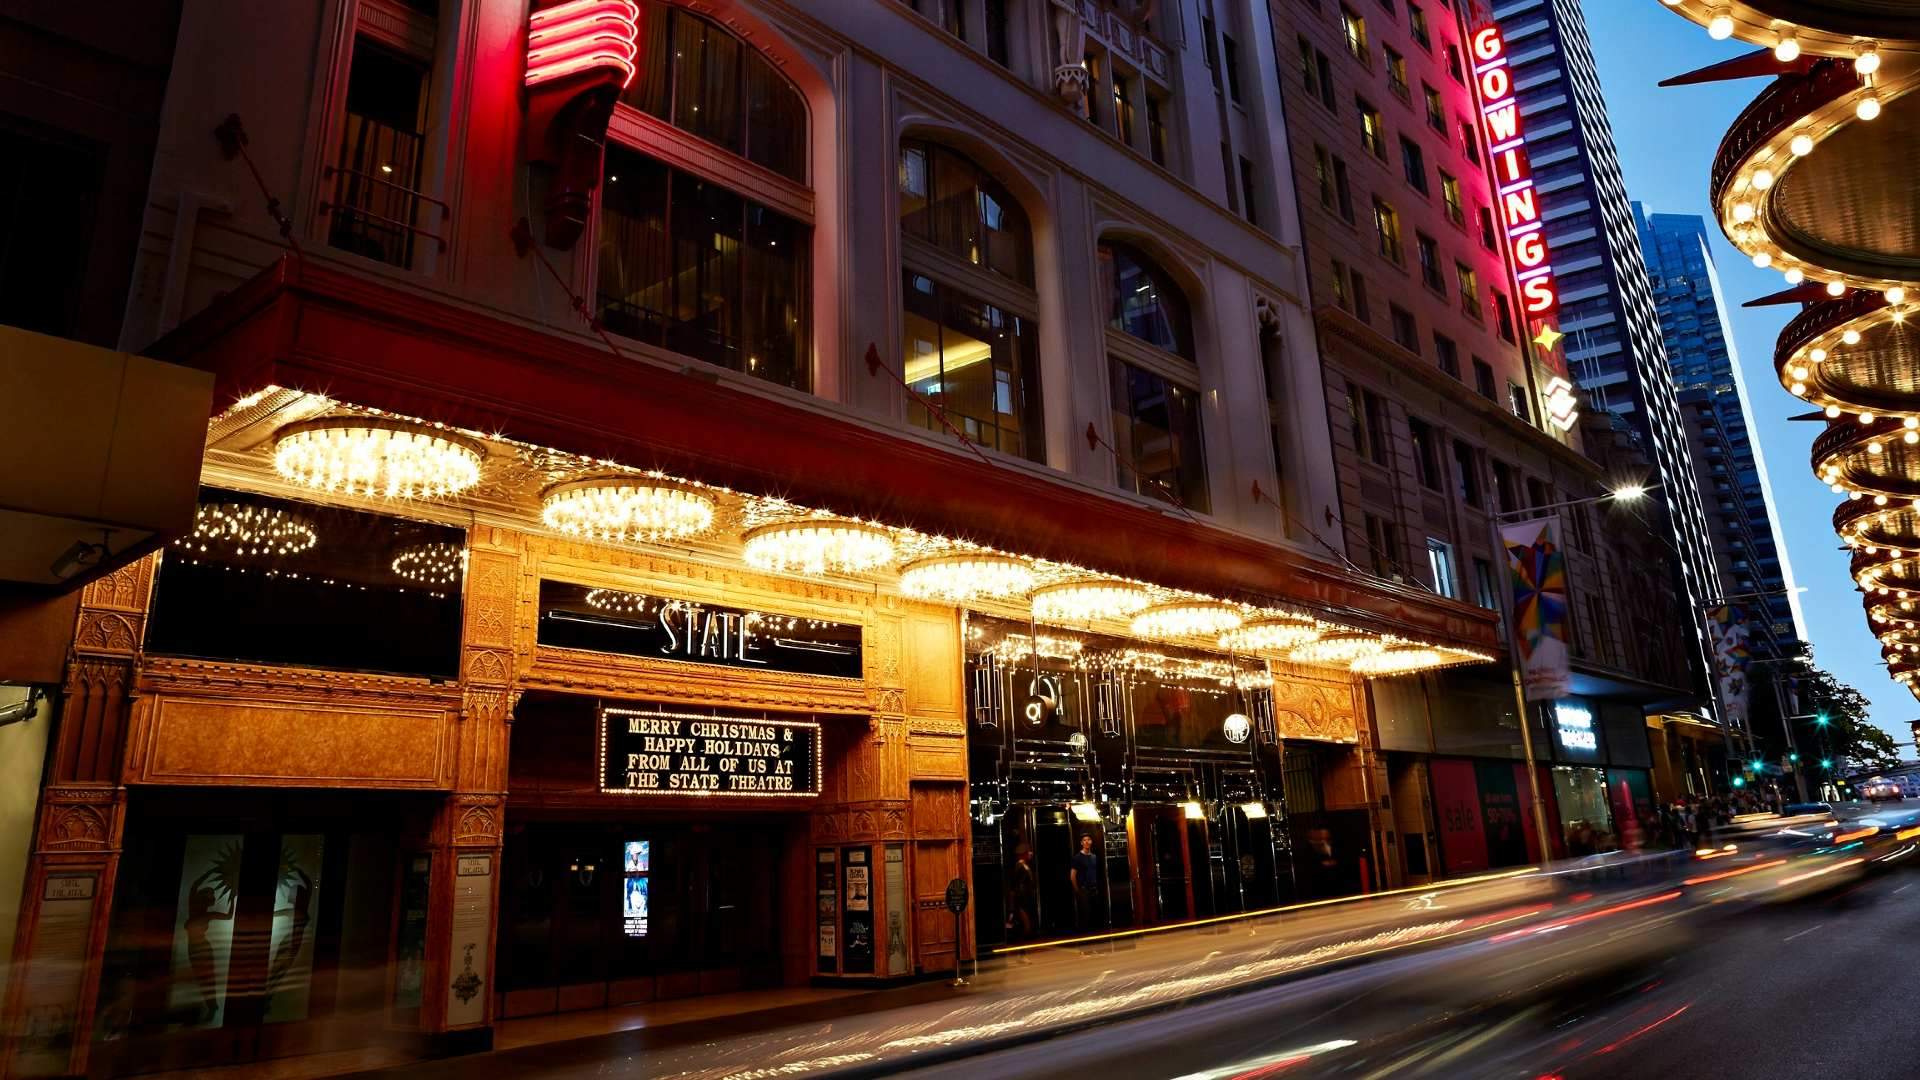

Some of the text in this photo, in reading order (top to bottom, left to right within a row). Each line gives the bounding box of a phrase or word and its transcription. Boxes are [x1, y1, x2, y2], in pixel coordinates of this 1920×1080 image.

[1474, 27, 1553, 314] GOWINGS
[660, 602, 768, 664] STATE
[628, 718, 793, 741] MERRY CHRISTMAS &
[644, 737, 780, 757] HAPPY HOLIDAYS
[628, 754, 793, 775] FROM ALL OF US AT
[627, 772, 793, 791] THE STATE THEATRE
